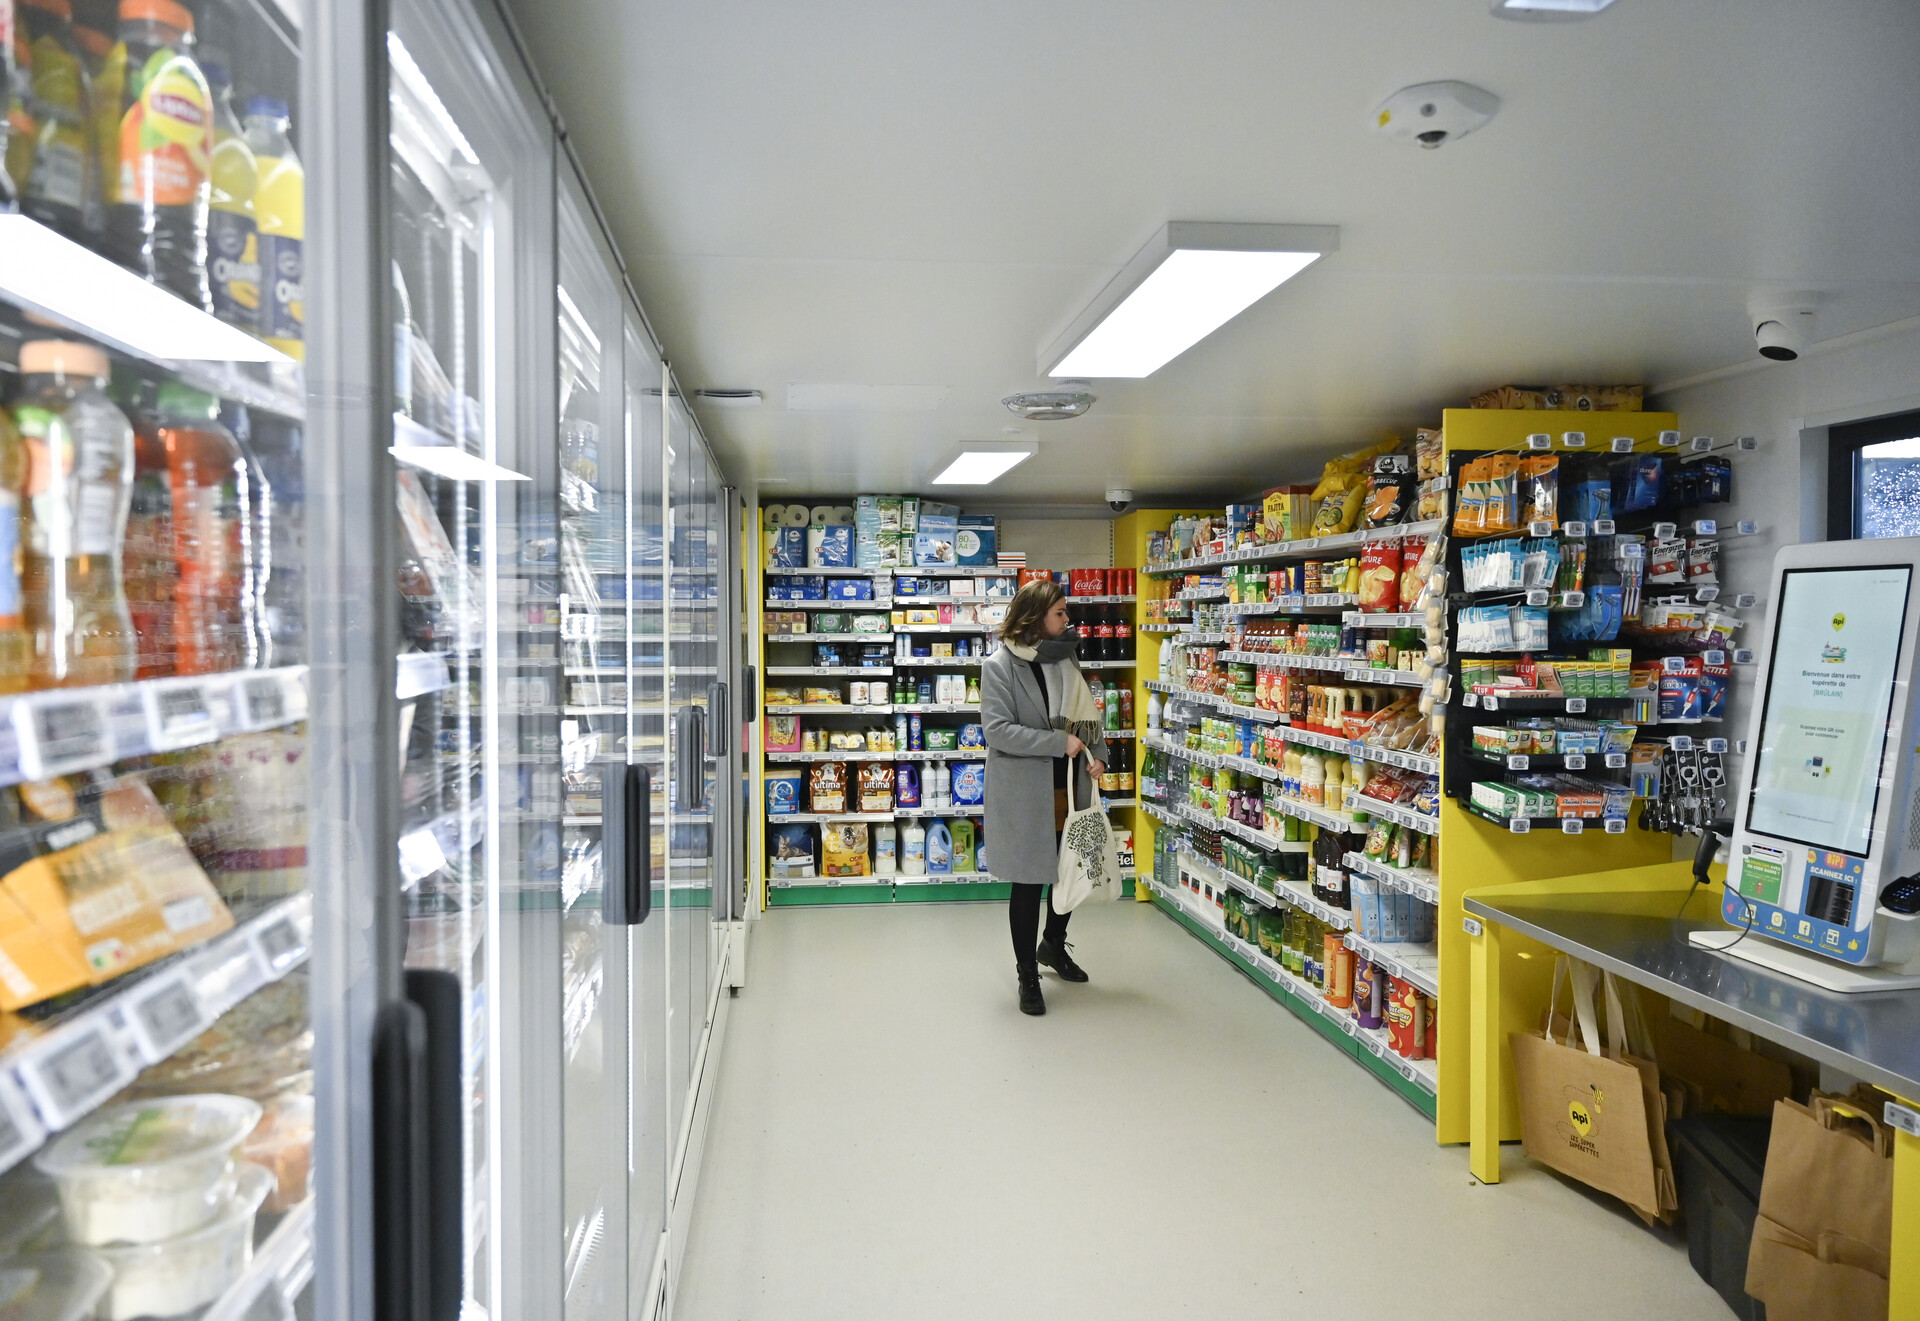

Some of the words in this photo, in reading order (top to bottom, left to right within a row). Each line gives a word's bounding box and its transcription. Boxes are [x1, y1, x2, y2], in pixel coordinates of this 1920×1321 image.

[958, 535, 969, 543] 80
[1654, 543, 1685, 555] Energizer
[1690, 544, 1718, 556] Energizer
[1404, 552, 1419, 561] ATURE
[1832, 618, 1844, 626] Api
[1515, 664, 1536, 674] YEUF
[1802, 670, 1830, 678] Bienvenue
[1474, 686, 1488, 694] YEUF
[814, 781, 840, 789] ultima
[864, 780, 890, 789] ultima
[1810, 866, 1842, 880] SCANNEZ
[1844, 874, 1854, 883] ICI
[1572, 1110, 1588, 1125] Api
[1570, 1135, 1578, 1143] LES
[1580, 1139, 1595, 1149] SUPER
[1569, 1141, 1600, 1158] SUPÉRETTES
